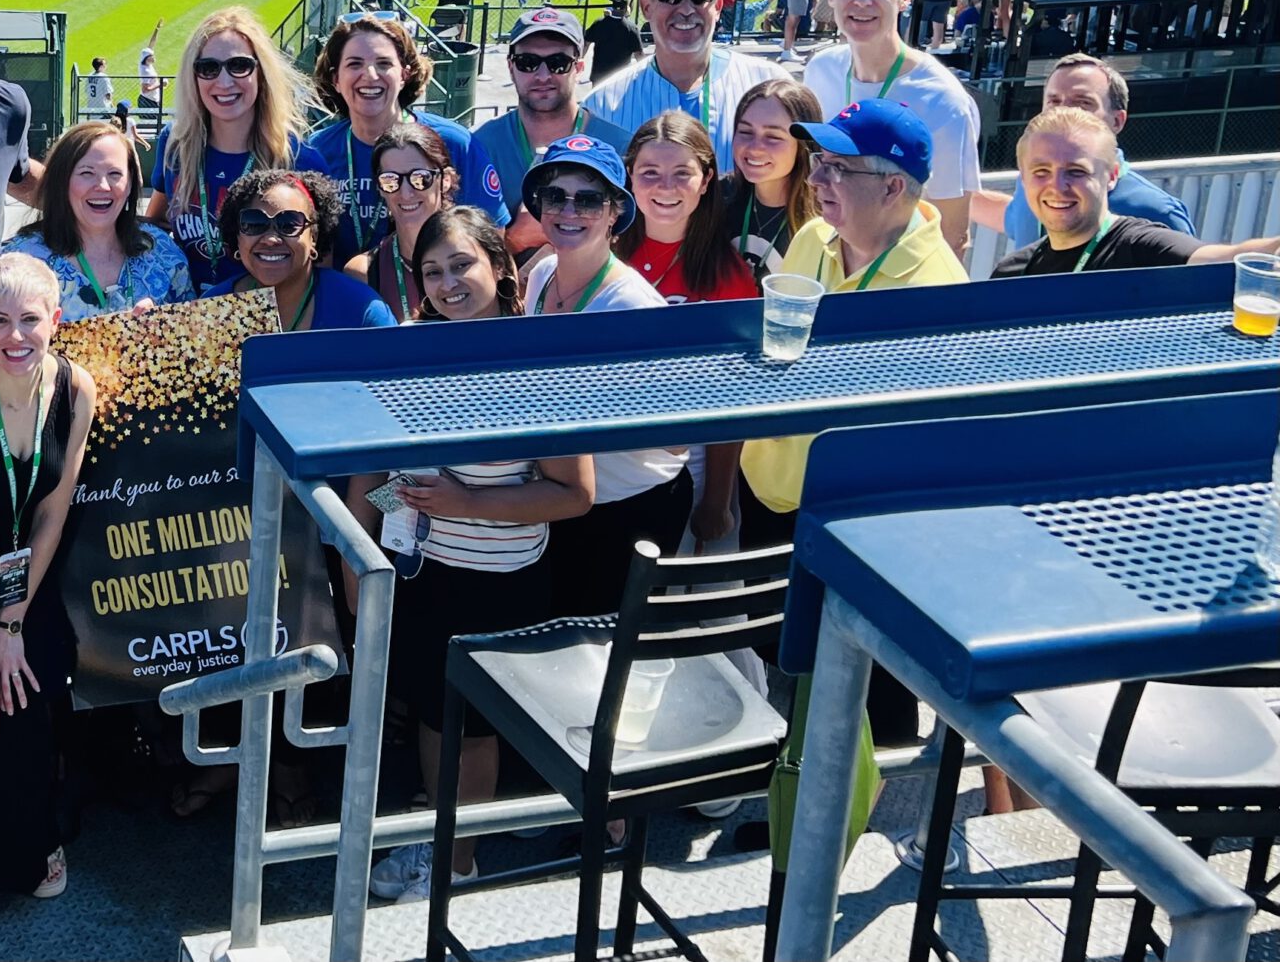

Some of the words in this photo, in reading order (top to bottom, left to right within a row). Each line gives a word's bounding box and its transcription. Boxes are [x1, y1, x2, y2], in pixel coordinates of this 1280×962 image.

[336, 192, 360, 205] HEN
[360, 178, 372, 191] IT
[350, 205, 388, 219] UBS
[126, 483, 162, 507] you
[166, 474, 185, 491] to
[189, 469, 221, 485] our
[106, 520, 155, 560] ONE
[157, 505, 253, 553] MILLION
[91, 554, 290, 616] CONSULTATIO!
[128, 625, 237, 662] CARPLS
[133, 659, 192, 678] everyday
[197, 654, 240, 672] justice
